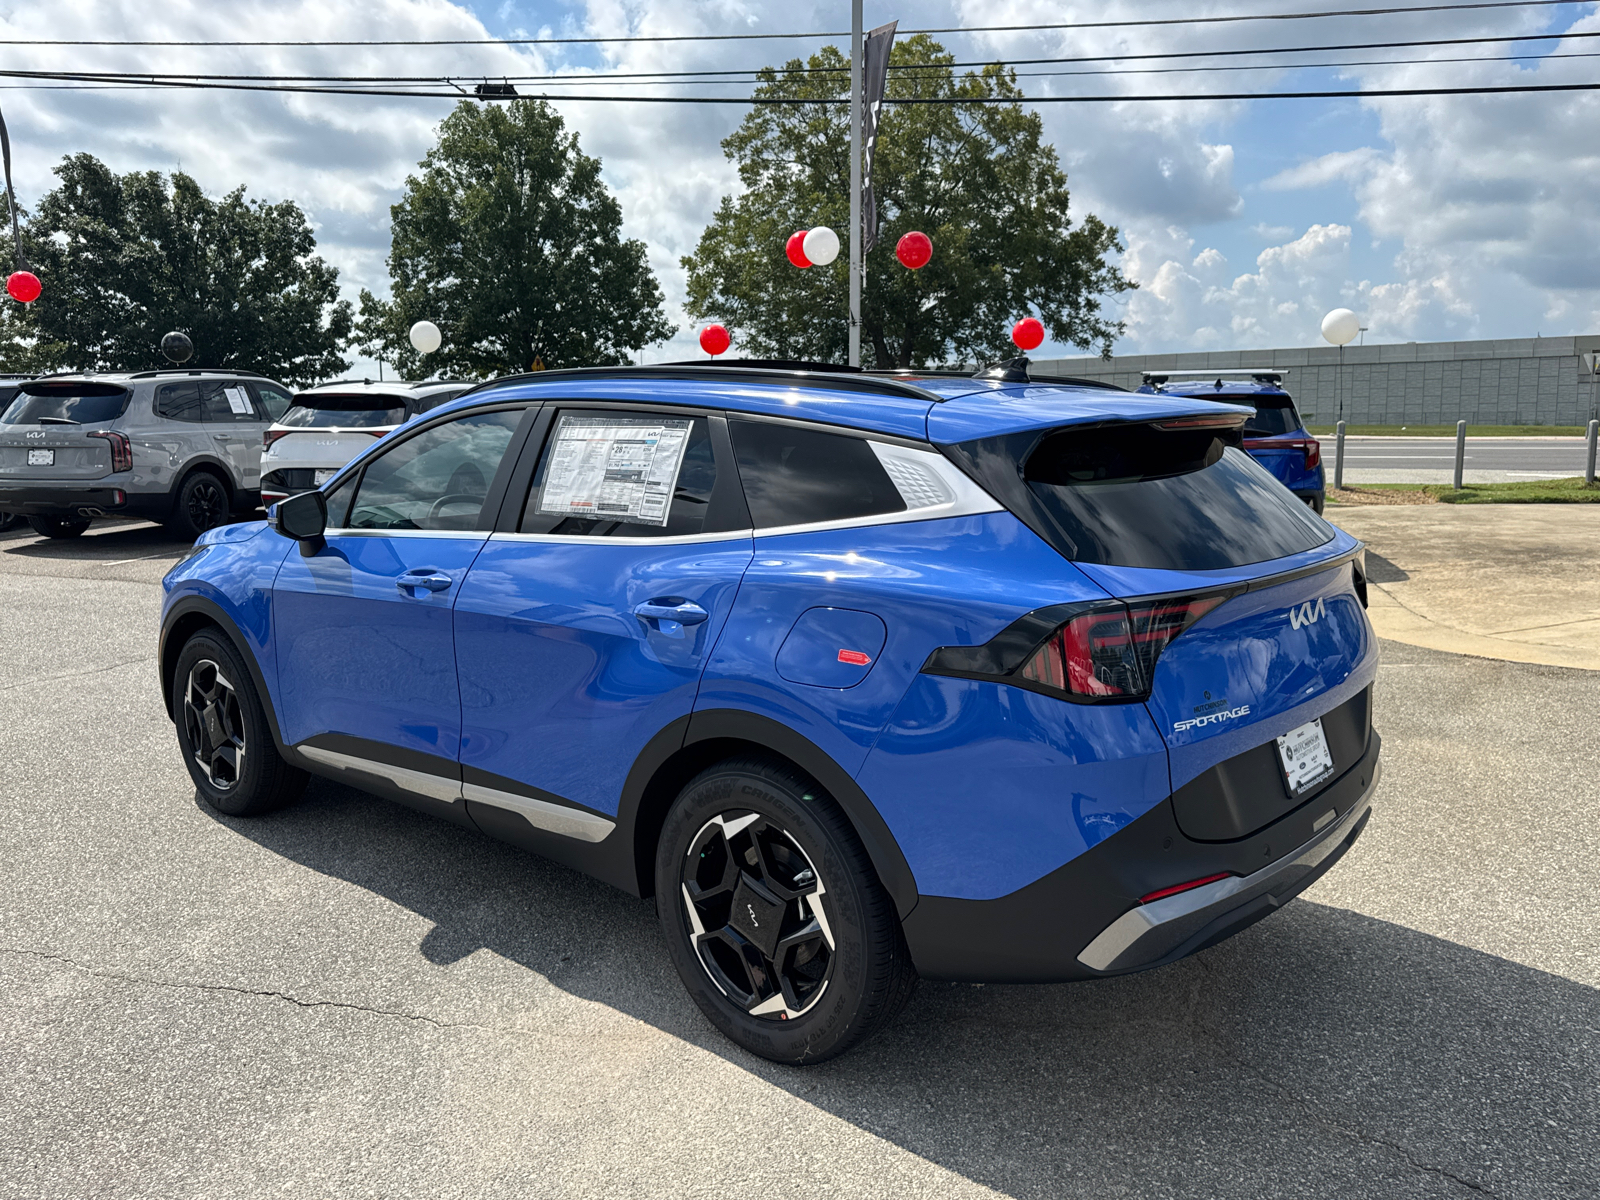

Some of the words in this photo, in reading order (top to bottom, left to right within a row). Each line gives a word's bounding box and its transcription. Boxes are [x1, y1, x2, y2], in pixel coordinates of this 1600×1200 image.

[1289, 596, 1326, 631] KIA
[1173, 704, 1251, 732] SPORTAGE
[1193, 698, 1228, 714] HUTCHINSON
[741, 785, 806, 828] CRUGEN
